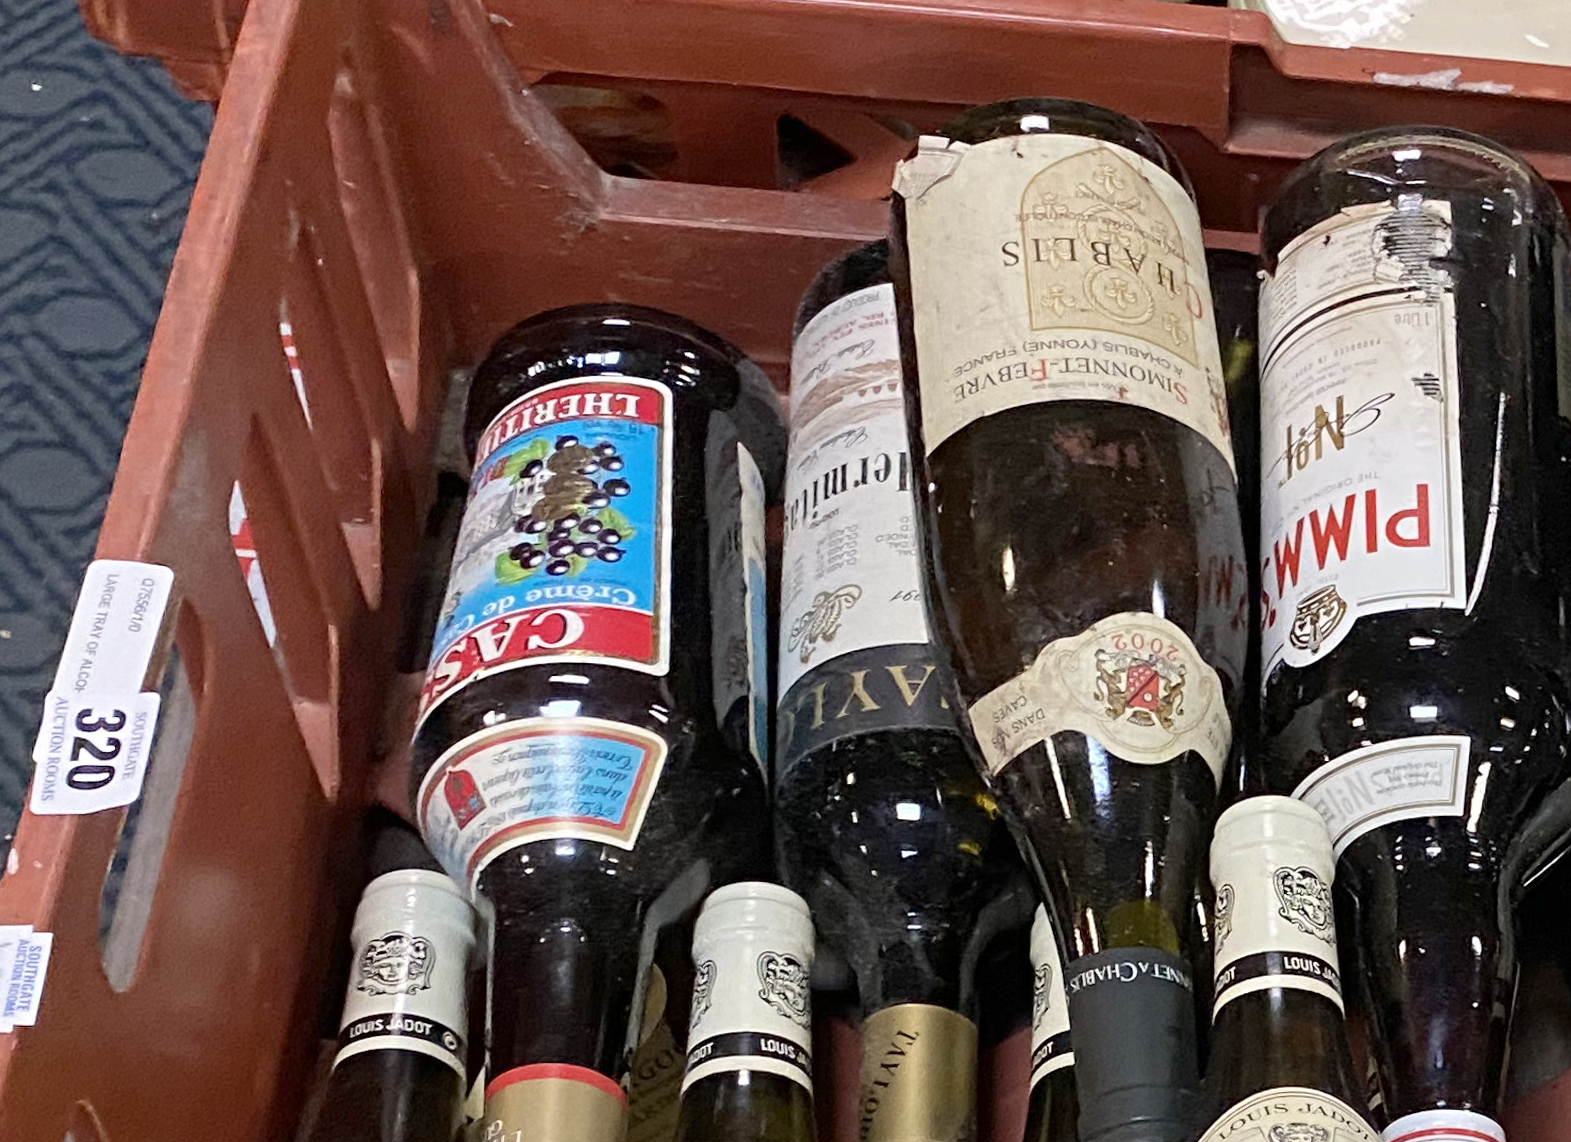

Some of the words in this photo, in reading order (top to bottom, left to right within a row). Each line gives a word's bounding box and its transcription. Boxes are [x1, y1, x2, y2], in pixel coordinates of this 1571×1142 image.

[1001, 237, 1202, 319] CHABLIS
[954, 348, 1016, 377] FRANCE
[1105, 341, 1172, 370] CHABLIS
[98, 574, 119, 608] LARGE
[526, 582, 637, 606] Crème
[482, 596, 516, 622] de
[90, 611, 108, 639] TRAY
[85, 641, 98, 656] OF
[1111, 633, 1179, 662] 2002
[993, 695, 1027, 723] CAVES
[1012, 708, 1045, 734] DANS
[49, 697, 68, 754] AUCTION
[66, 708, 126, 790] 320
[122, 711, 147, 780] SOUTHGATE
[41, 757, 61, 801] ROOMS
[11, 939, 30, 981] AUCTION
[1283, 955, 1321, 976] LOUIS
[17, 945, 42, 1012] SOUTHGATE
[1070, 962, 1138, 993] CHABLIS
[349, 1018, 386, 1039] LOUIS
[387, 1016, 433, 1036] JADOT
[760, 1037, 796, 1059] LOUIS
[1219, 1102, 1289, 1141] LOUIS
[1297, 1103, 1371, 1142] JADOT
